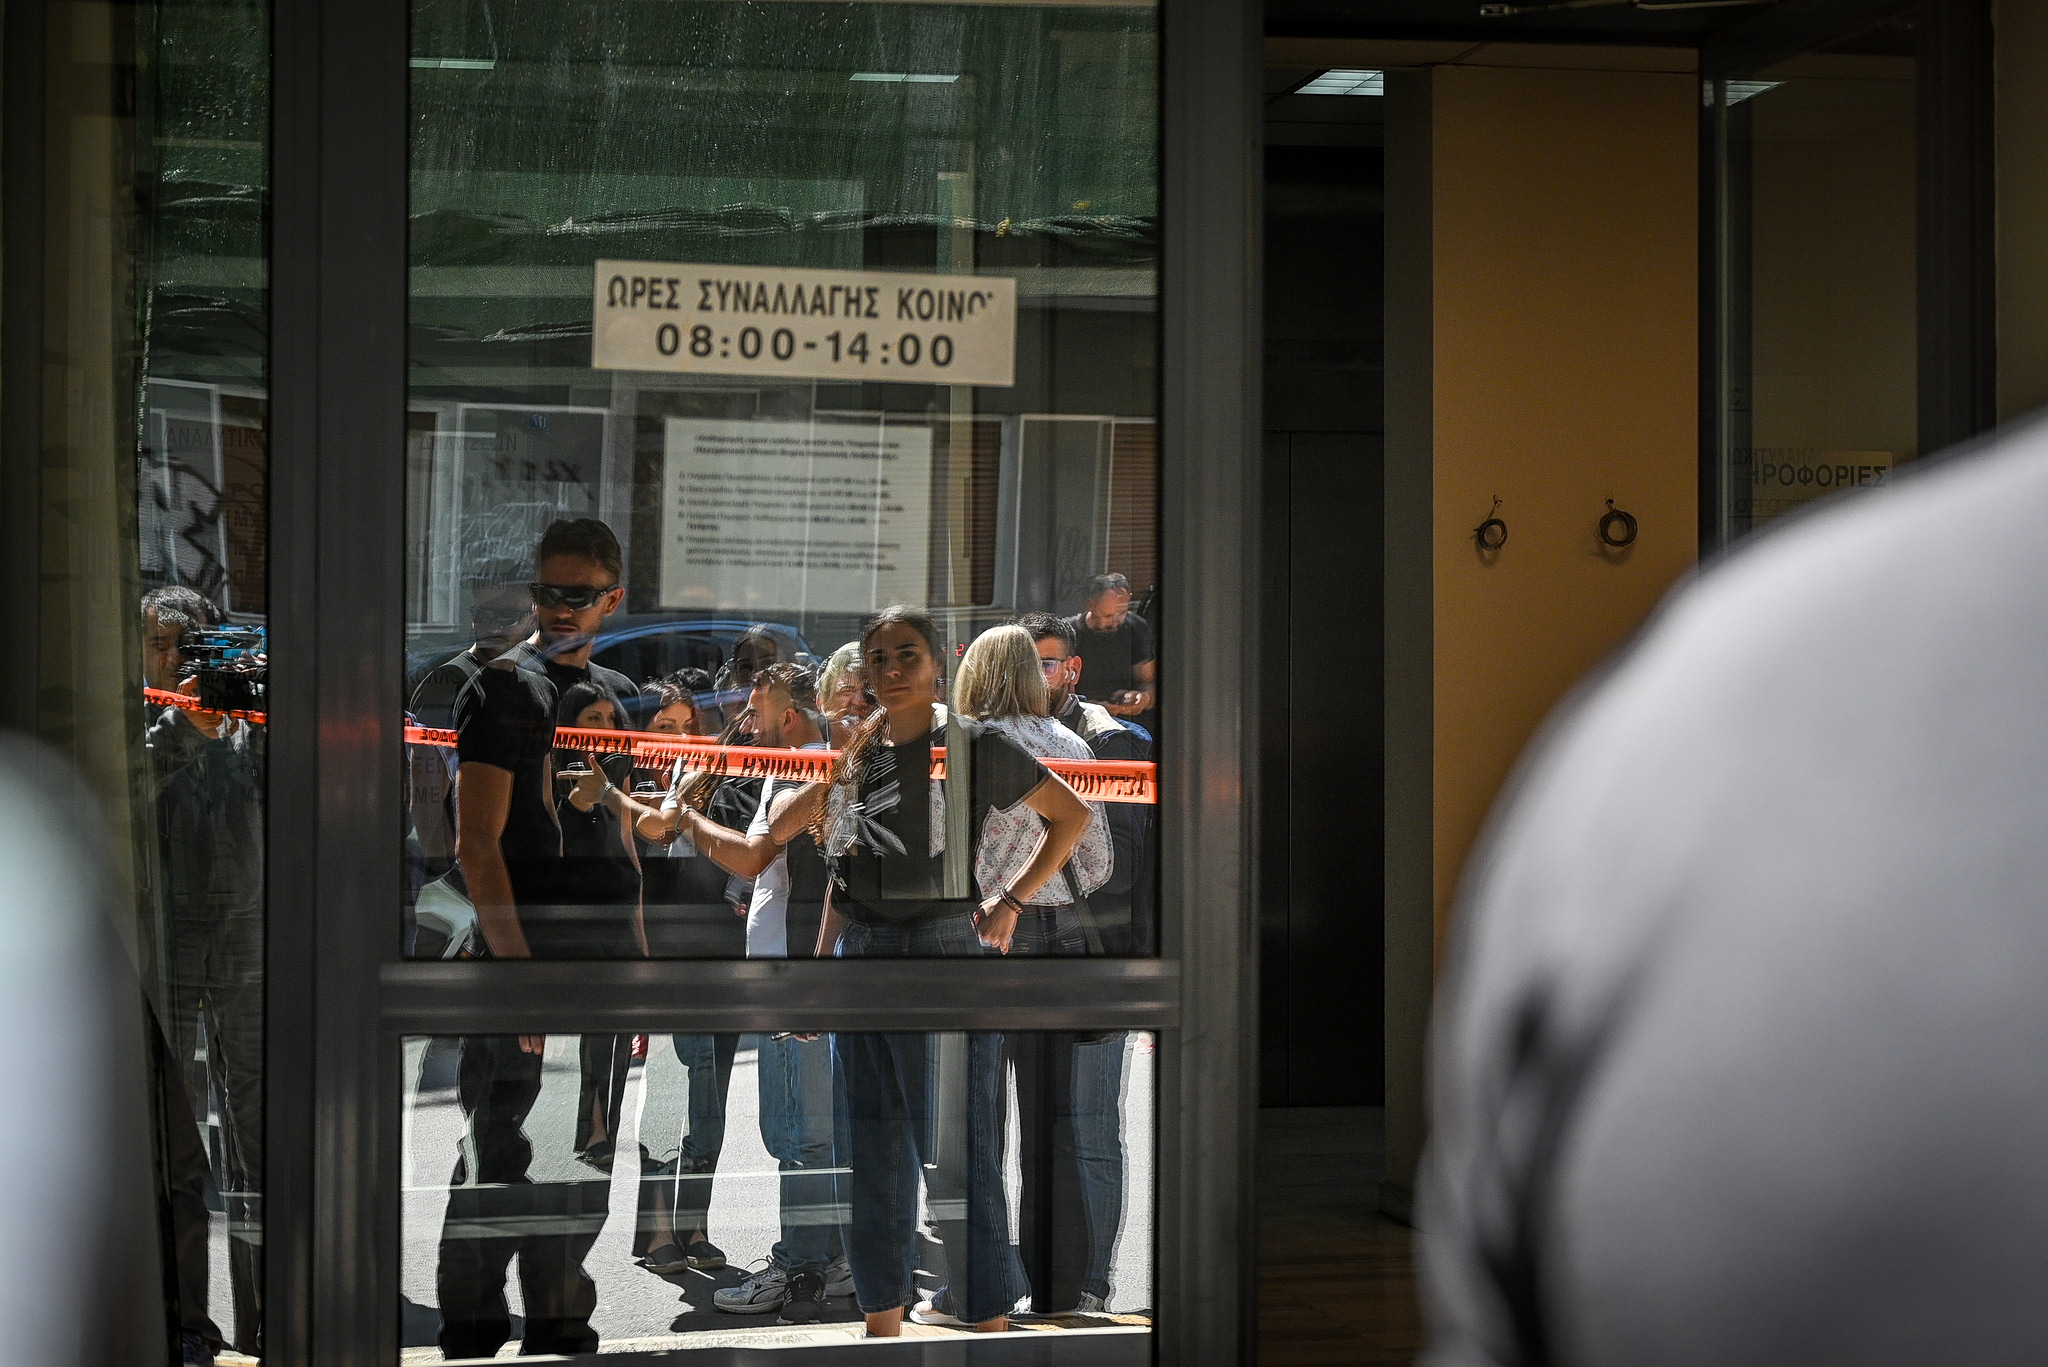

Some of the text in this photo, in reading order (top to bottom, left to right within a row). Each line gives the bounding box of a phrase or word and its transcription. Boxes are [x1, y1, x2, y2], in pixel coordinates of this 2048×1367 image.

[606, 274, 994, 323] ΩΡΕΣ ΣΥΝΑΛΛΑΓΗΣ ΚΟΙΝΟ
[655, 323, 954, 367] 08:00-14:00
